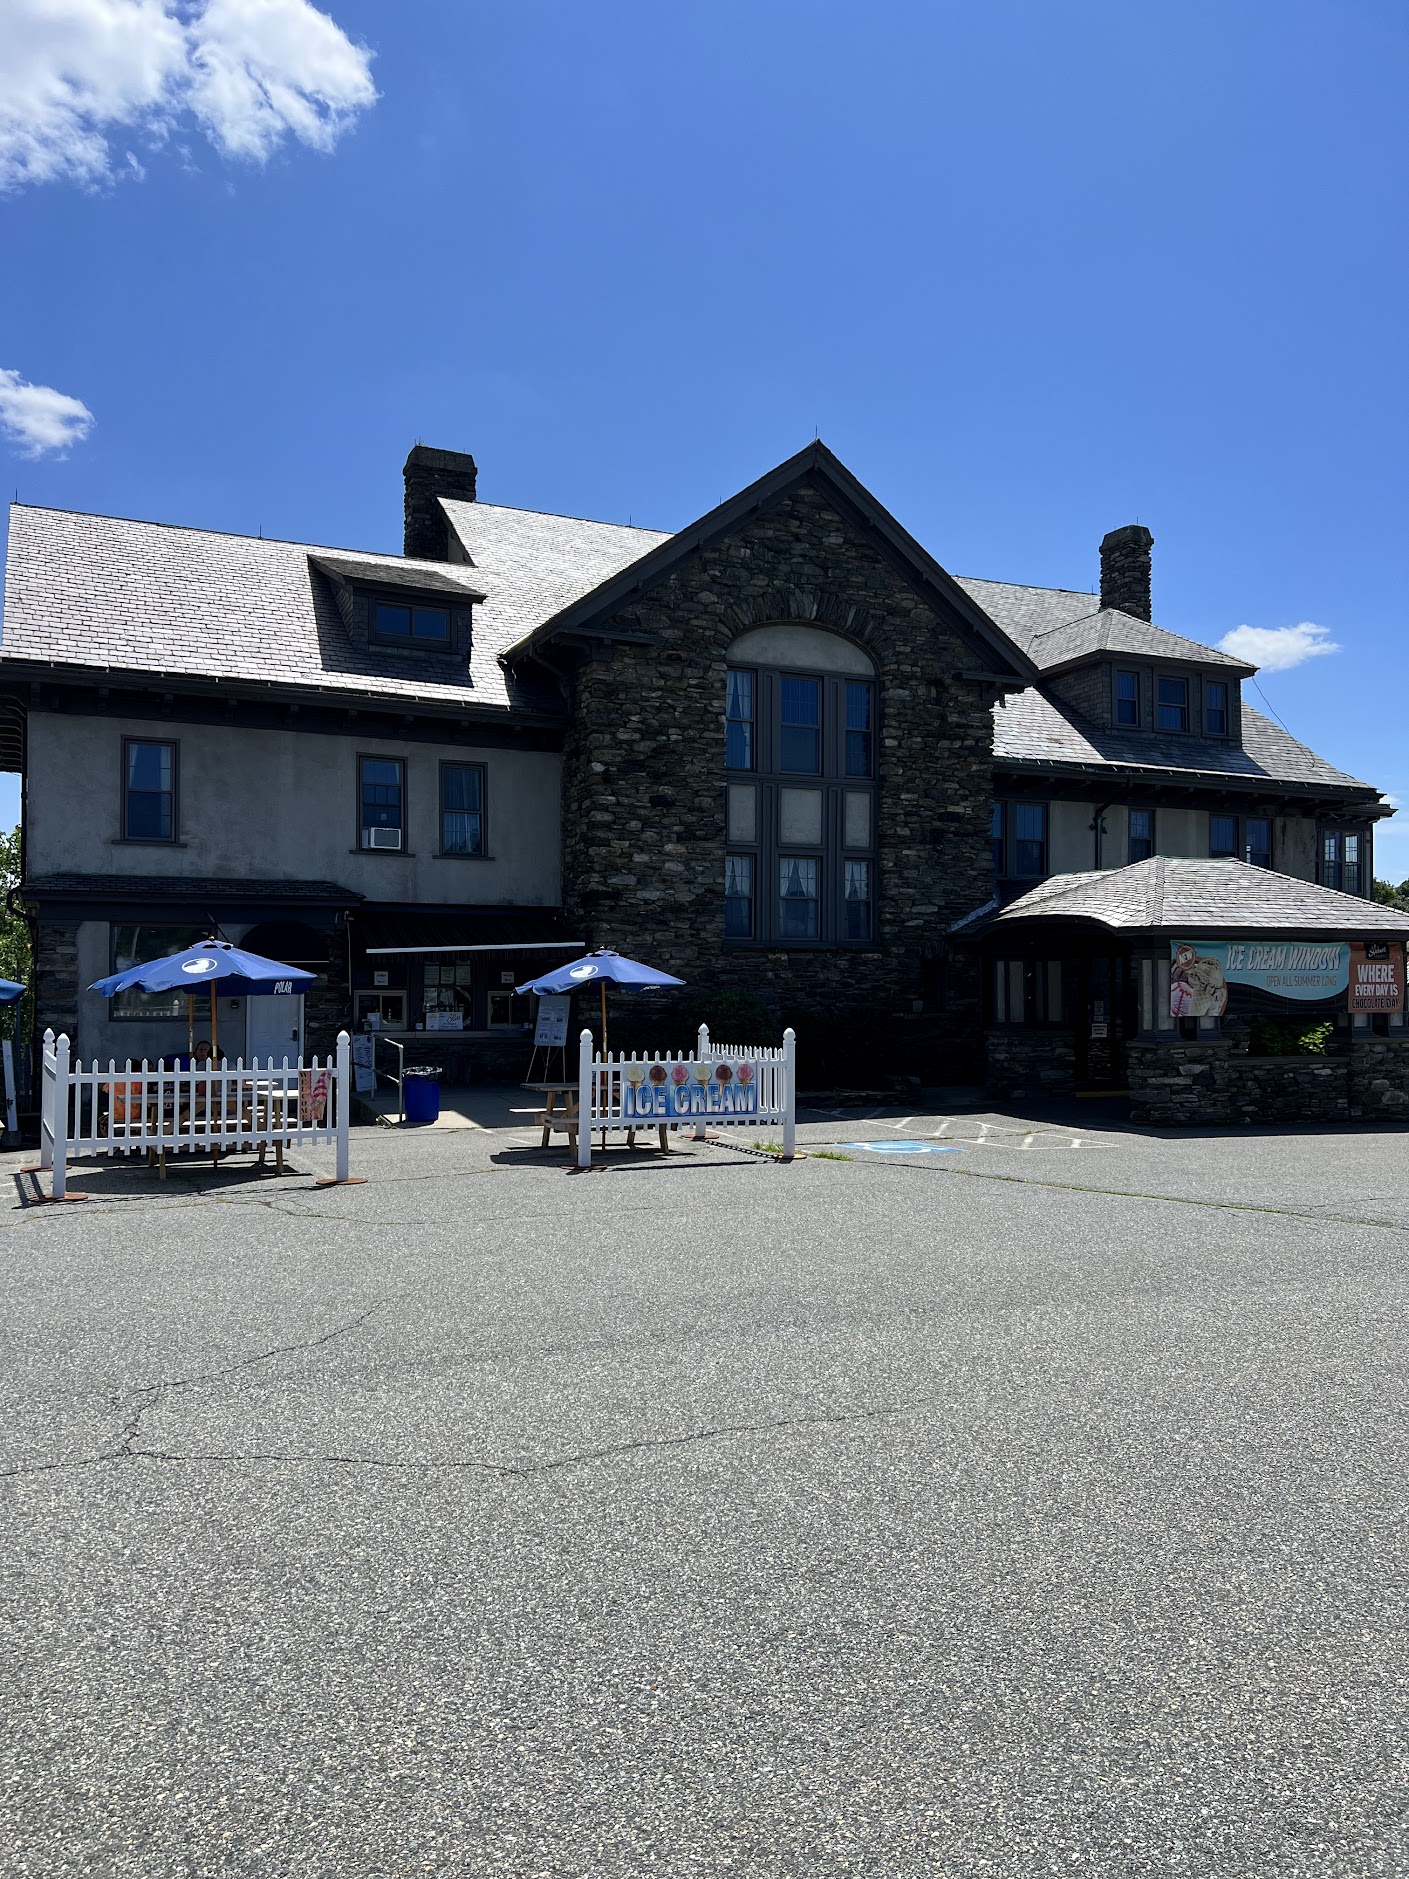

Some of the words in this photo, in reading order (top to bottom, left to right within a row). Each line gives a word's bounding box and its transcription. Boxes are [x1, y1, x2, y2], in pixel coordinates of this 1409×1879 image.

[1178, 949, 1194, 965] NEW
[1226, 945, 1246, 970] ICE
[1247, 945, 1288, 970] CREAM
[1288, 946, 1341, 971] WINDOW
[1266, 975, 1281, 987] OPEN
[1282, 975, 1294, 987] ALL
[1294, 975, 1321, 987] SUMMER
[1321, 975, 1337, 987] LONG
[1357, 964, 1395, 983] WHERE
[273, 980, 293, 995] POLAR
[1355, 984, 1375, 997] EVERY
[1375, 984, 1389, 996] DAY
[1390, 984, 1399, 996] IS
[1351, 998, 1385, 1009] CHOCOLATE
[1386, 998, 1400, 1008] DAY
[299, 1072, 308, 1121] WELCOME
[626, 1084, 667, 1116] ICE
[673, 1082, 755, 1115] CREAM
